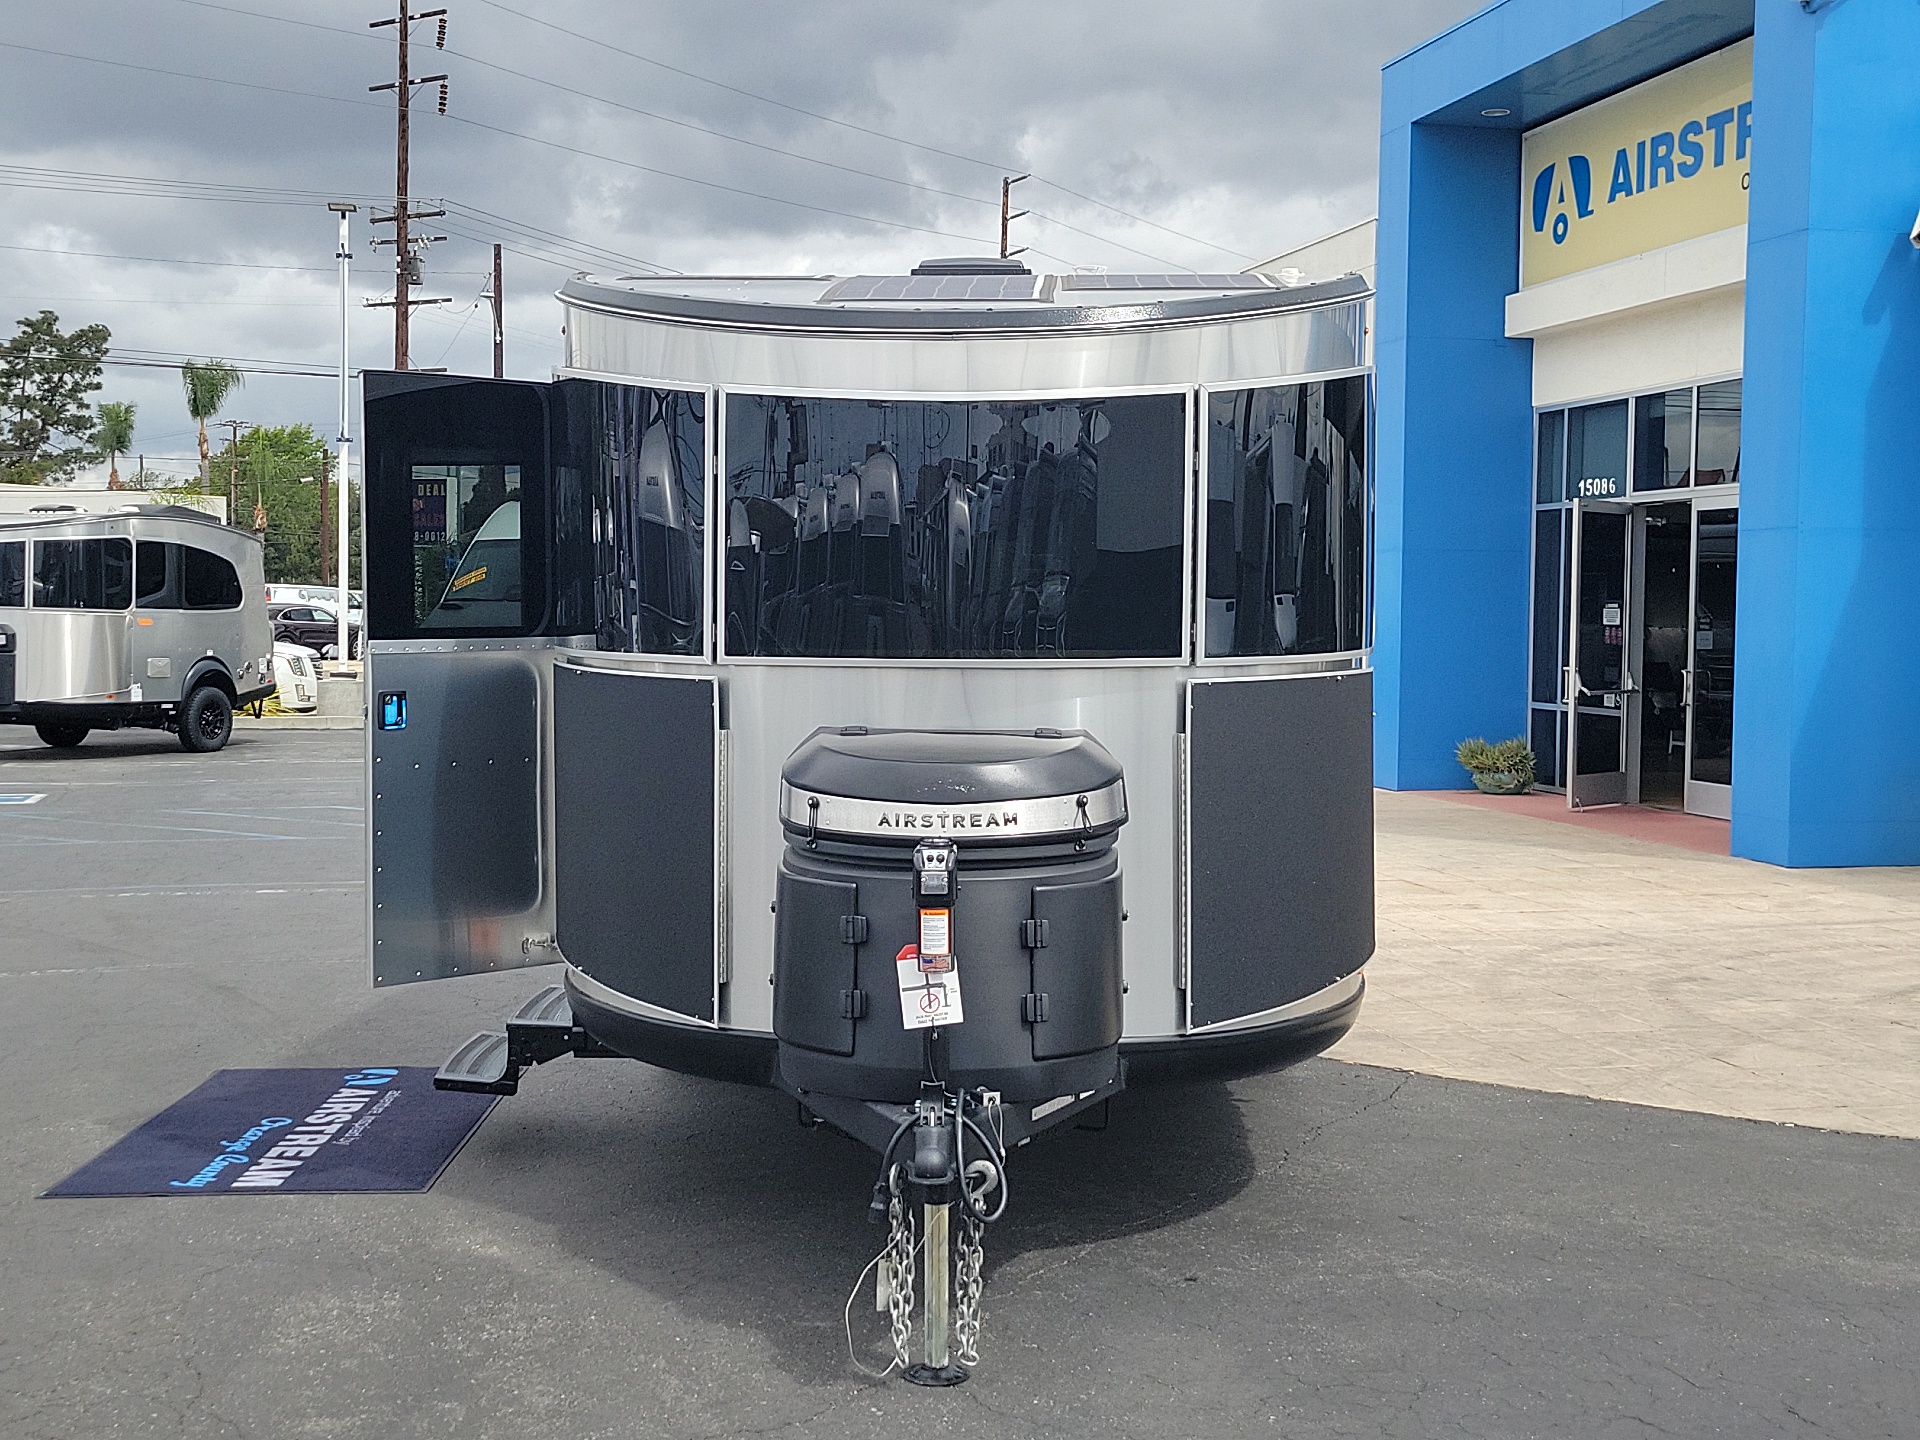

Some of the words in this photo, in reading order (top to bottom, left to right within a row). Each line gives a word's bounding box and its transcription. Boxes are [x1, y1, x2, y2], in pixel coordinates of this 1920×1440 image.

[1578, 477, 1616, 496] 15086
[878, 811, 1019, 829] AIRSTREAM
[220, 1116, 294, 1152] Orange
[230, 1088, 379, 1187] AIRSTREAM
[169, 1154, 249, 1188] County
